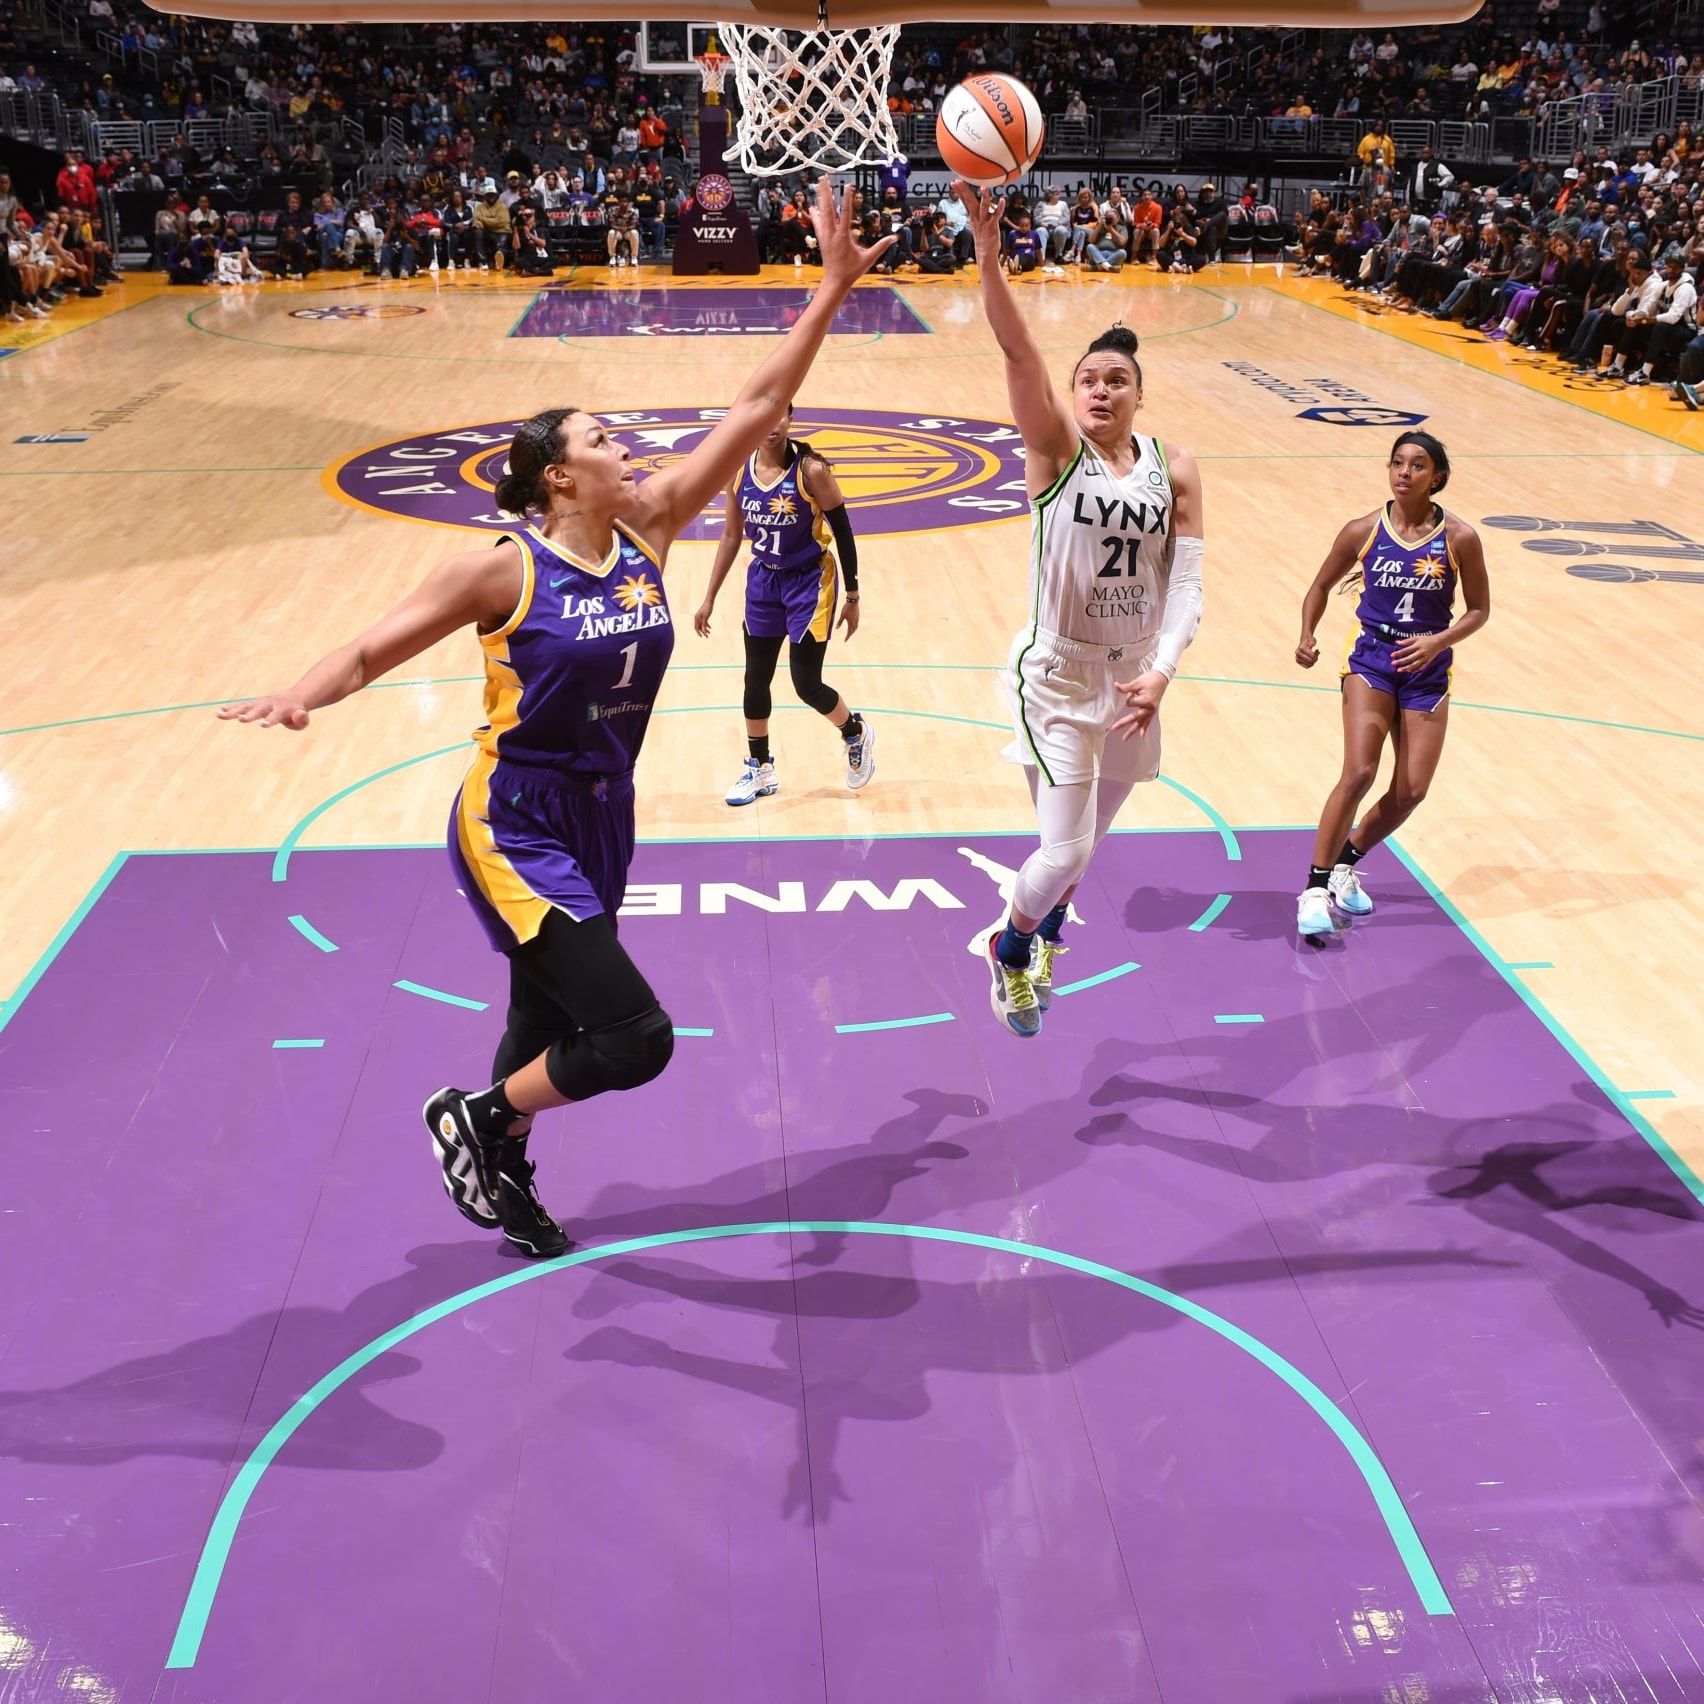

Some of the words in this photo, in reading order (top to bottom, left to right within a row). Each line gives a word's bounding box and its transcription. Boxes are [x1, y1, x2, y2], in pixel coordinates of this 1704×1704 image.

[972, 76, 1015, 127] Wilson
[692, 227, 738, 239] VIZZY
[745, 510, 799, 526] ANGELES
[1073, 492, 1169, 536] LYNX
[754, 526, 782, 556] 21
[1097, 536, 1142, 577] 21
[1091, 584, 1144, 601] MAYO
[1374, 573, 1446, 591] ANGELES
[1085, 600, 1148, 619] CLINIC
[1394, 592, 1415, 622] 4
[575, 604, 670, 641] ANGELES
[609, 641, 639, 690] 1
